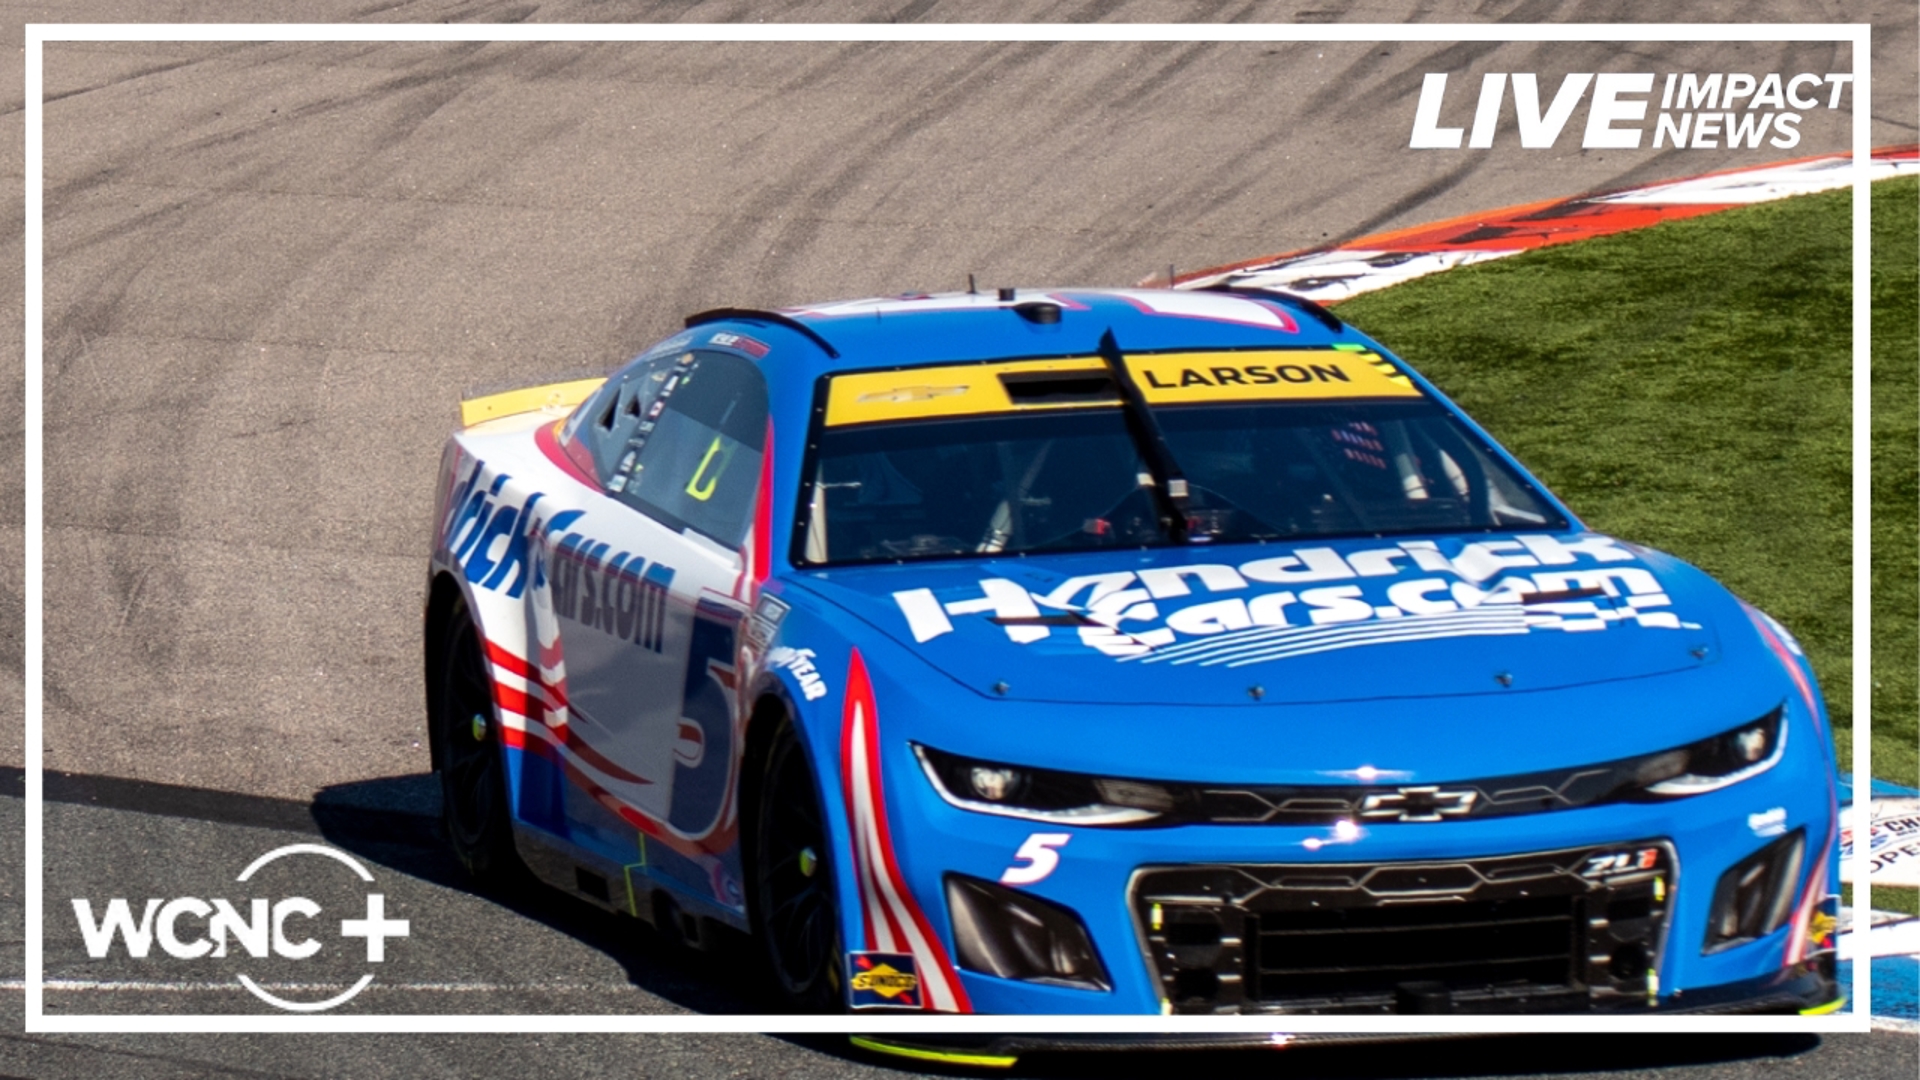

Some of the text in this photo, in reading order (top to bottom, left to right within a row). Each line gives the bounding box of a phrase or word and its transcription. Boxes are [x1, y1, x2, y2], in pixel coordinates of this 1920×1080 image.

[1143, 363, 1351, 389] LARSON
[892, 534, 1636, 643] Hendrick
[1000, 832, 1073, 885] 5
[857, 973, 915, 989] SUNOCO
